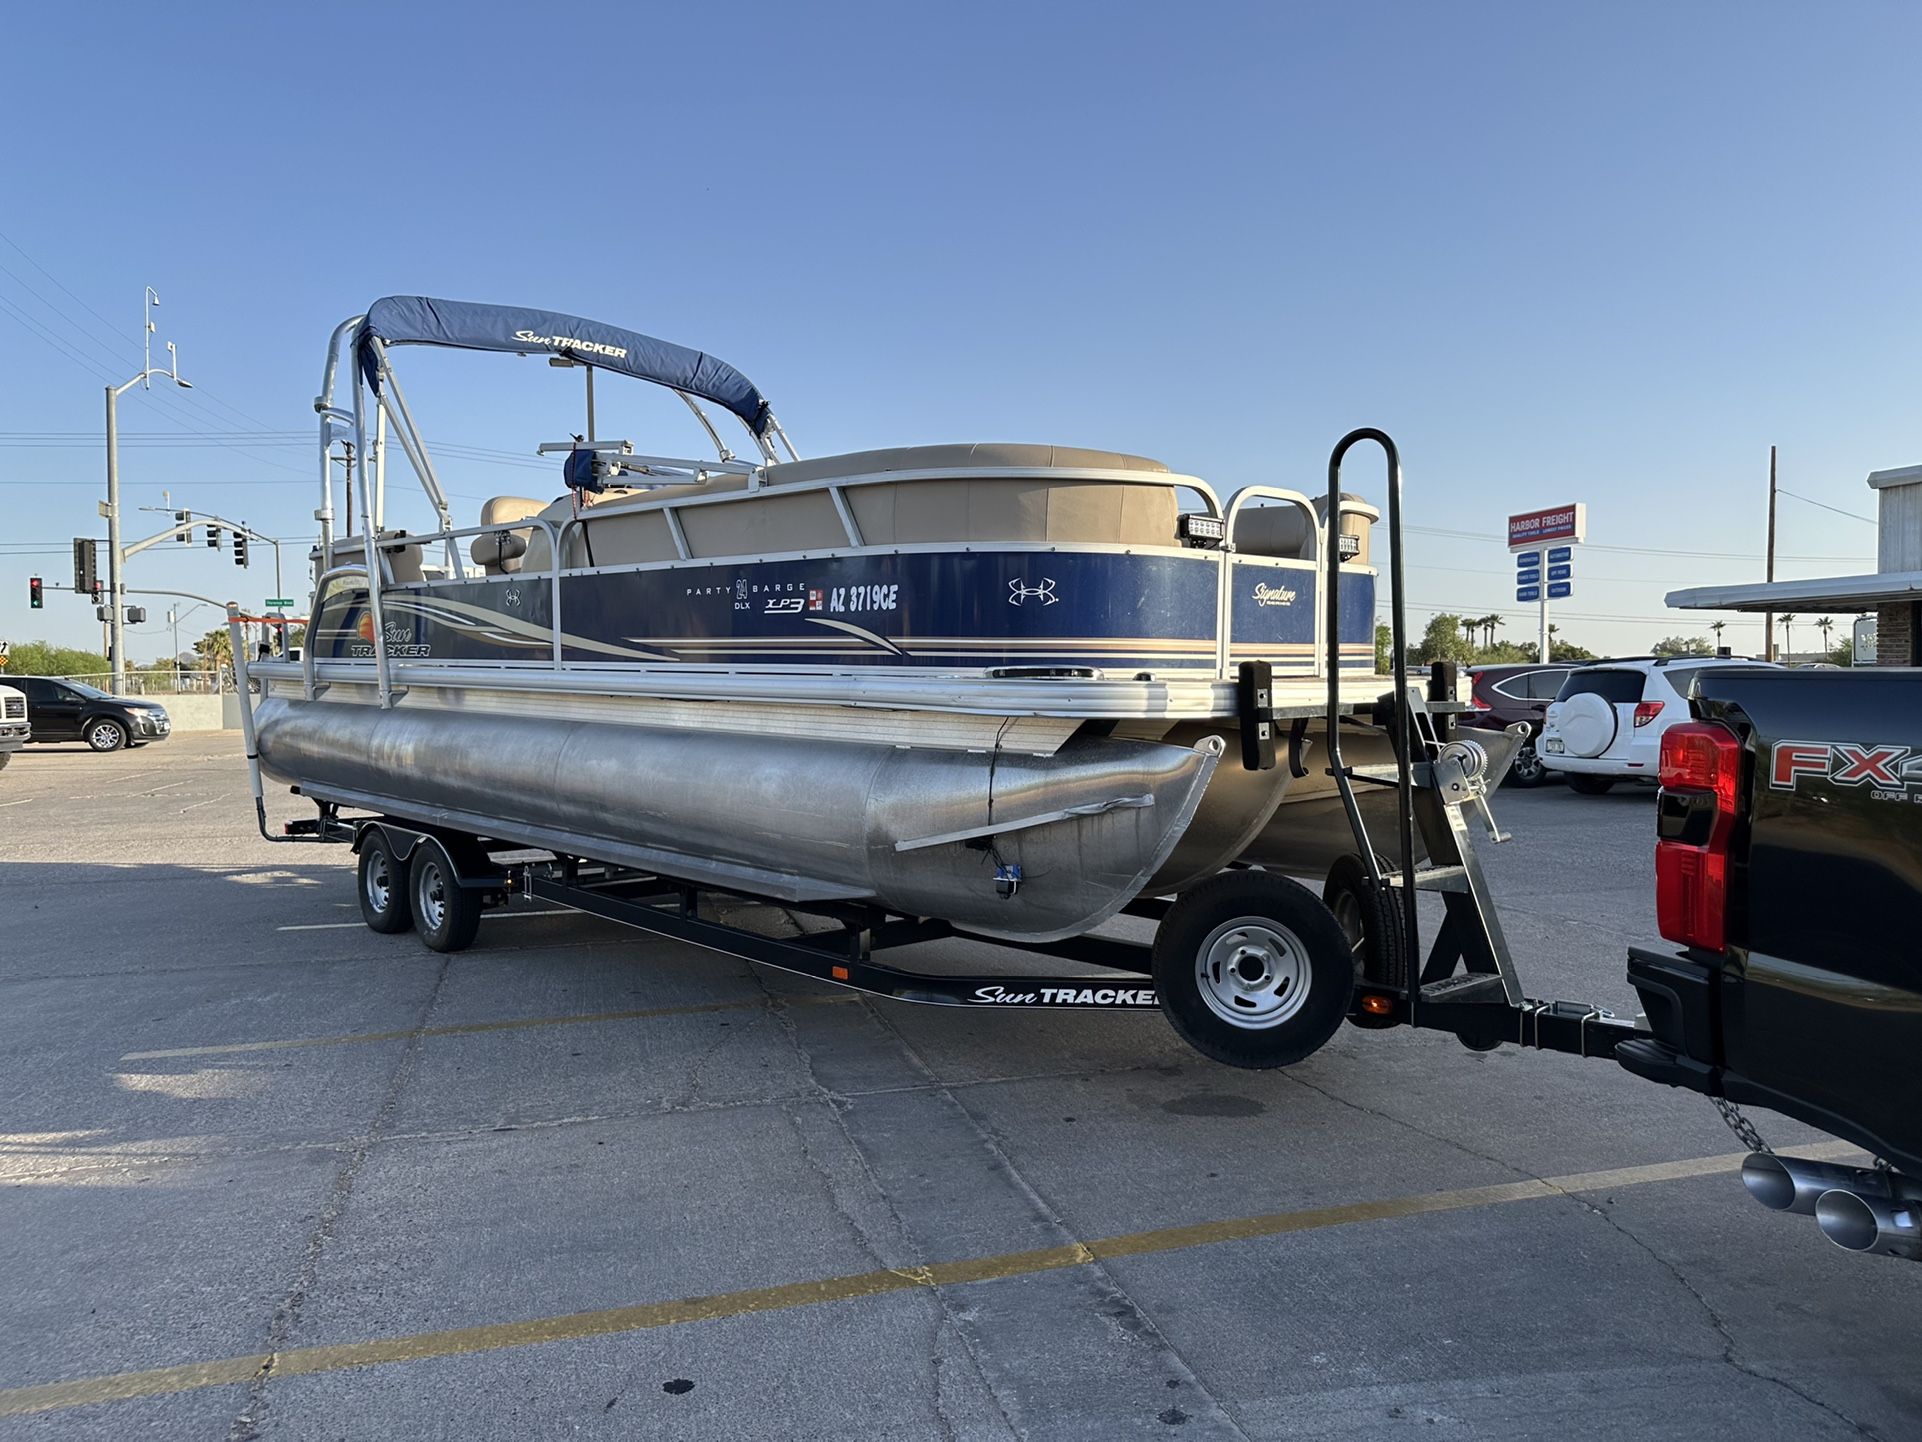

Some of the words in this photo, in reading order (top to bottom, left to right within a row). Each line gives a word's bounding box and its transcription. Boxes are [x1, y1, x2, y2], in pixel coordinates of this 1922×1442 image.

[512, 330, 552, 344] Sun
[552, 336, 627, 358] TRACKER
[1510, 518, 1540, 533] HARBOR
[1542, 511, 1574, 527] FREIGHT
[687, 587, 731, 596] PARTY
[752, 583, 805, 593] BARGE
[830, 587, 845, 613] AZ
[1252, 583, 1296, 606] Signature
[734, 602, 750, 610] DLX
[384, 621, 412, 643] Sun
[1871, 790, 1908, 801] OFF
[967, 986, 1037, 1004] Sun
